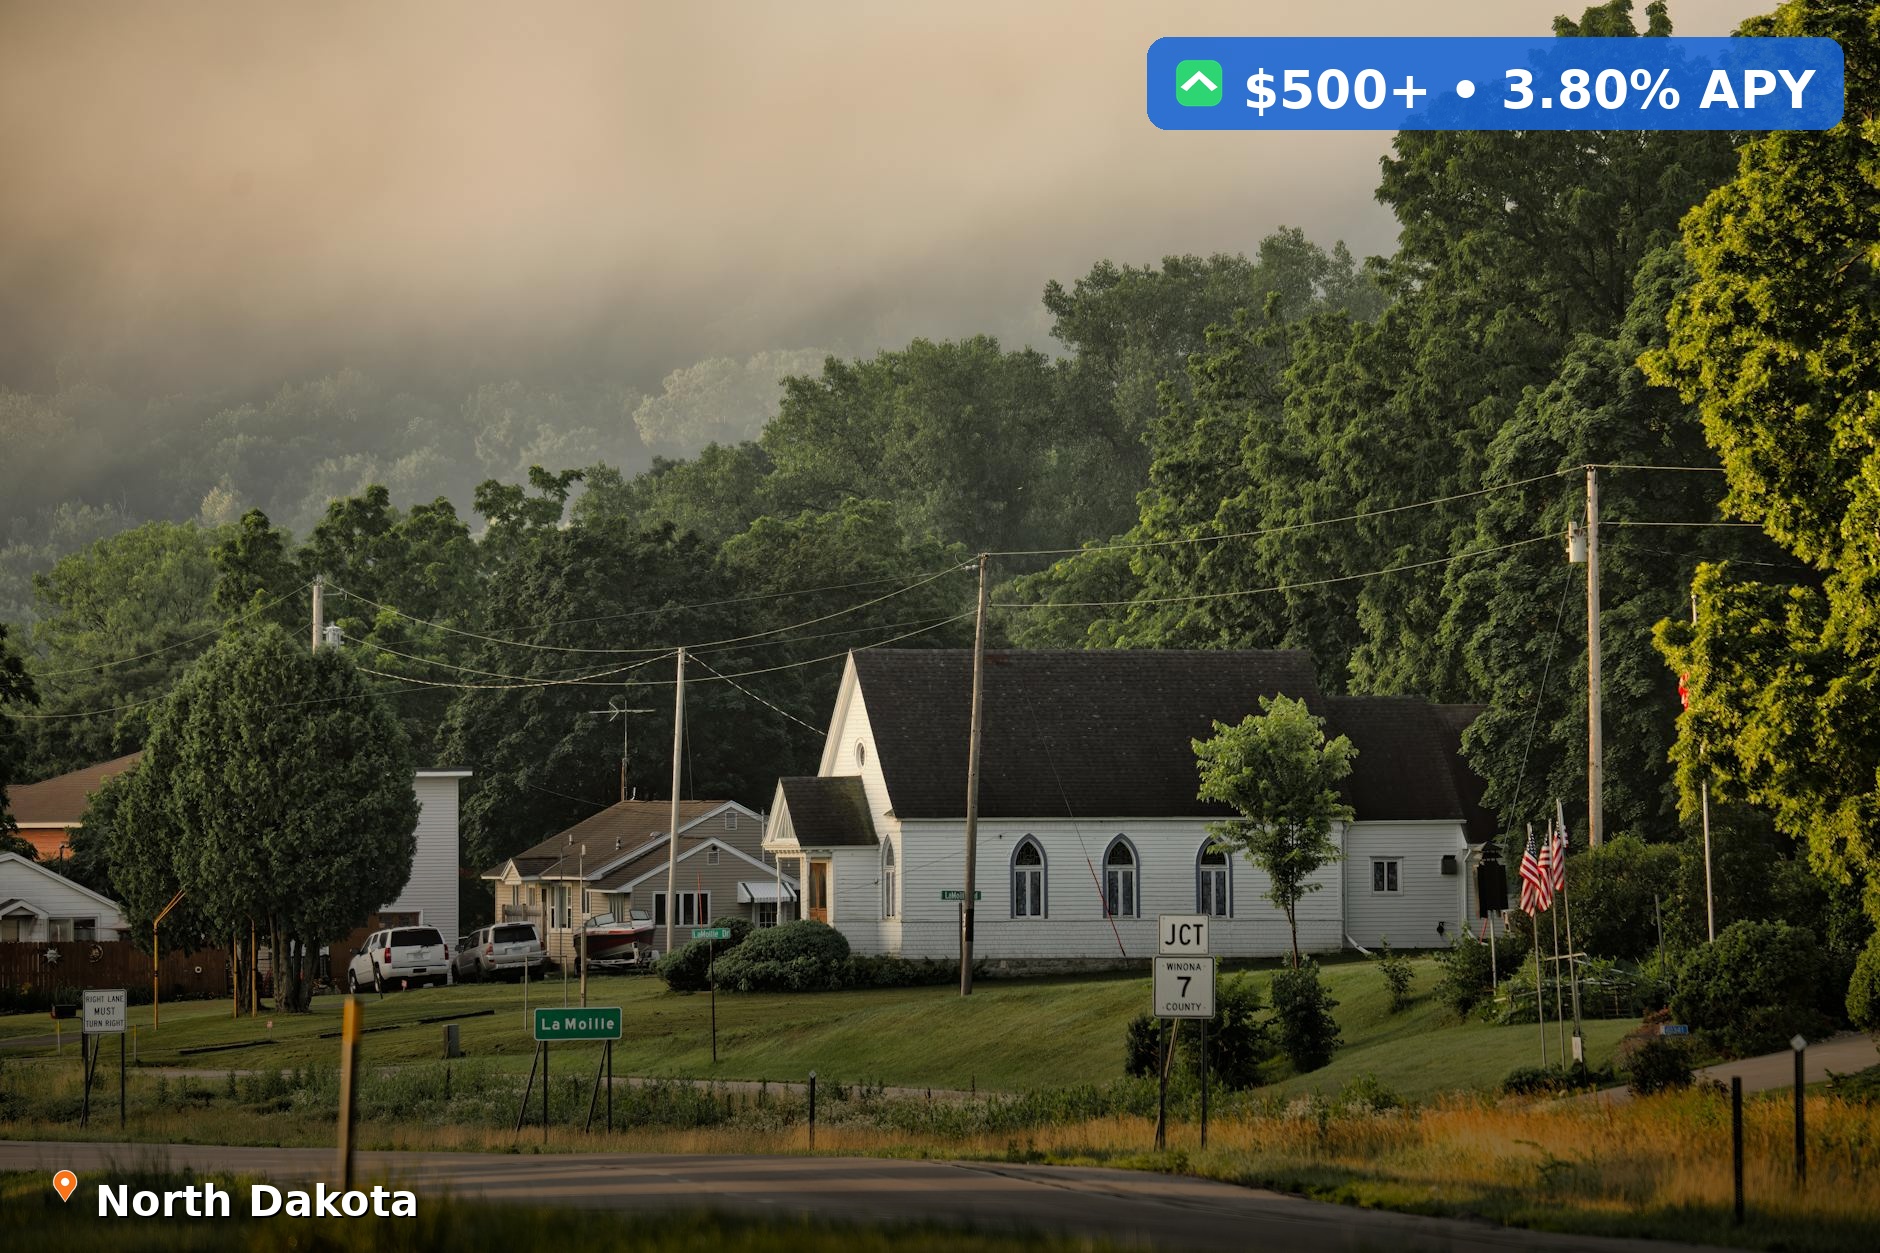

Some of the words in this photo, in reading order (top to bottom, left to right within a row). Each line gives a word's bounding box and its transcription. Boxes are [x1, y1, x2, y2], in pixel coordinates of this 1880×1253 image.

[1165, 923, 1204, 946] JCT
[1166, 962, 1202, 971] WINONA
[1177, 976, 1191, 998] 7
[85, 995, 104, 1003] RIGHT
[107, 994, 125, 1003] LANE
[1166, 1002, 1202, 1011] COUNTY
[94, 1007, 115, 1016] MUST
[85, 1020, 103, 1028] TURN
[105, 1019, 124, 1027] RIGHT
[541, 1018, 560, 1031] La
[564, 1017, 615, 1030] Moille
